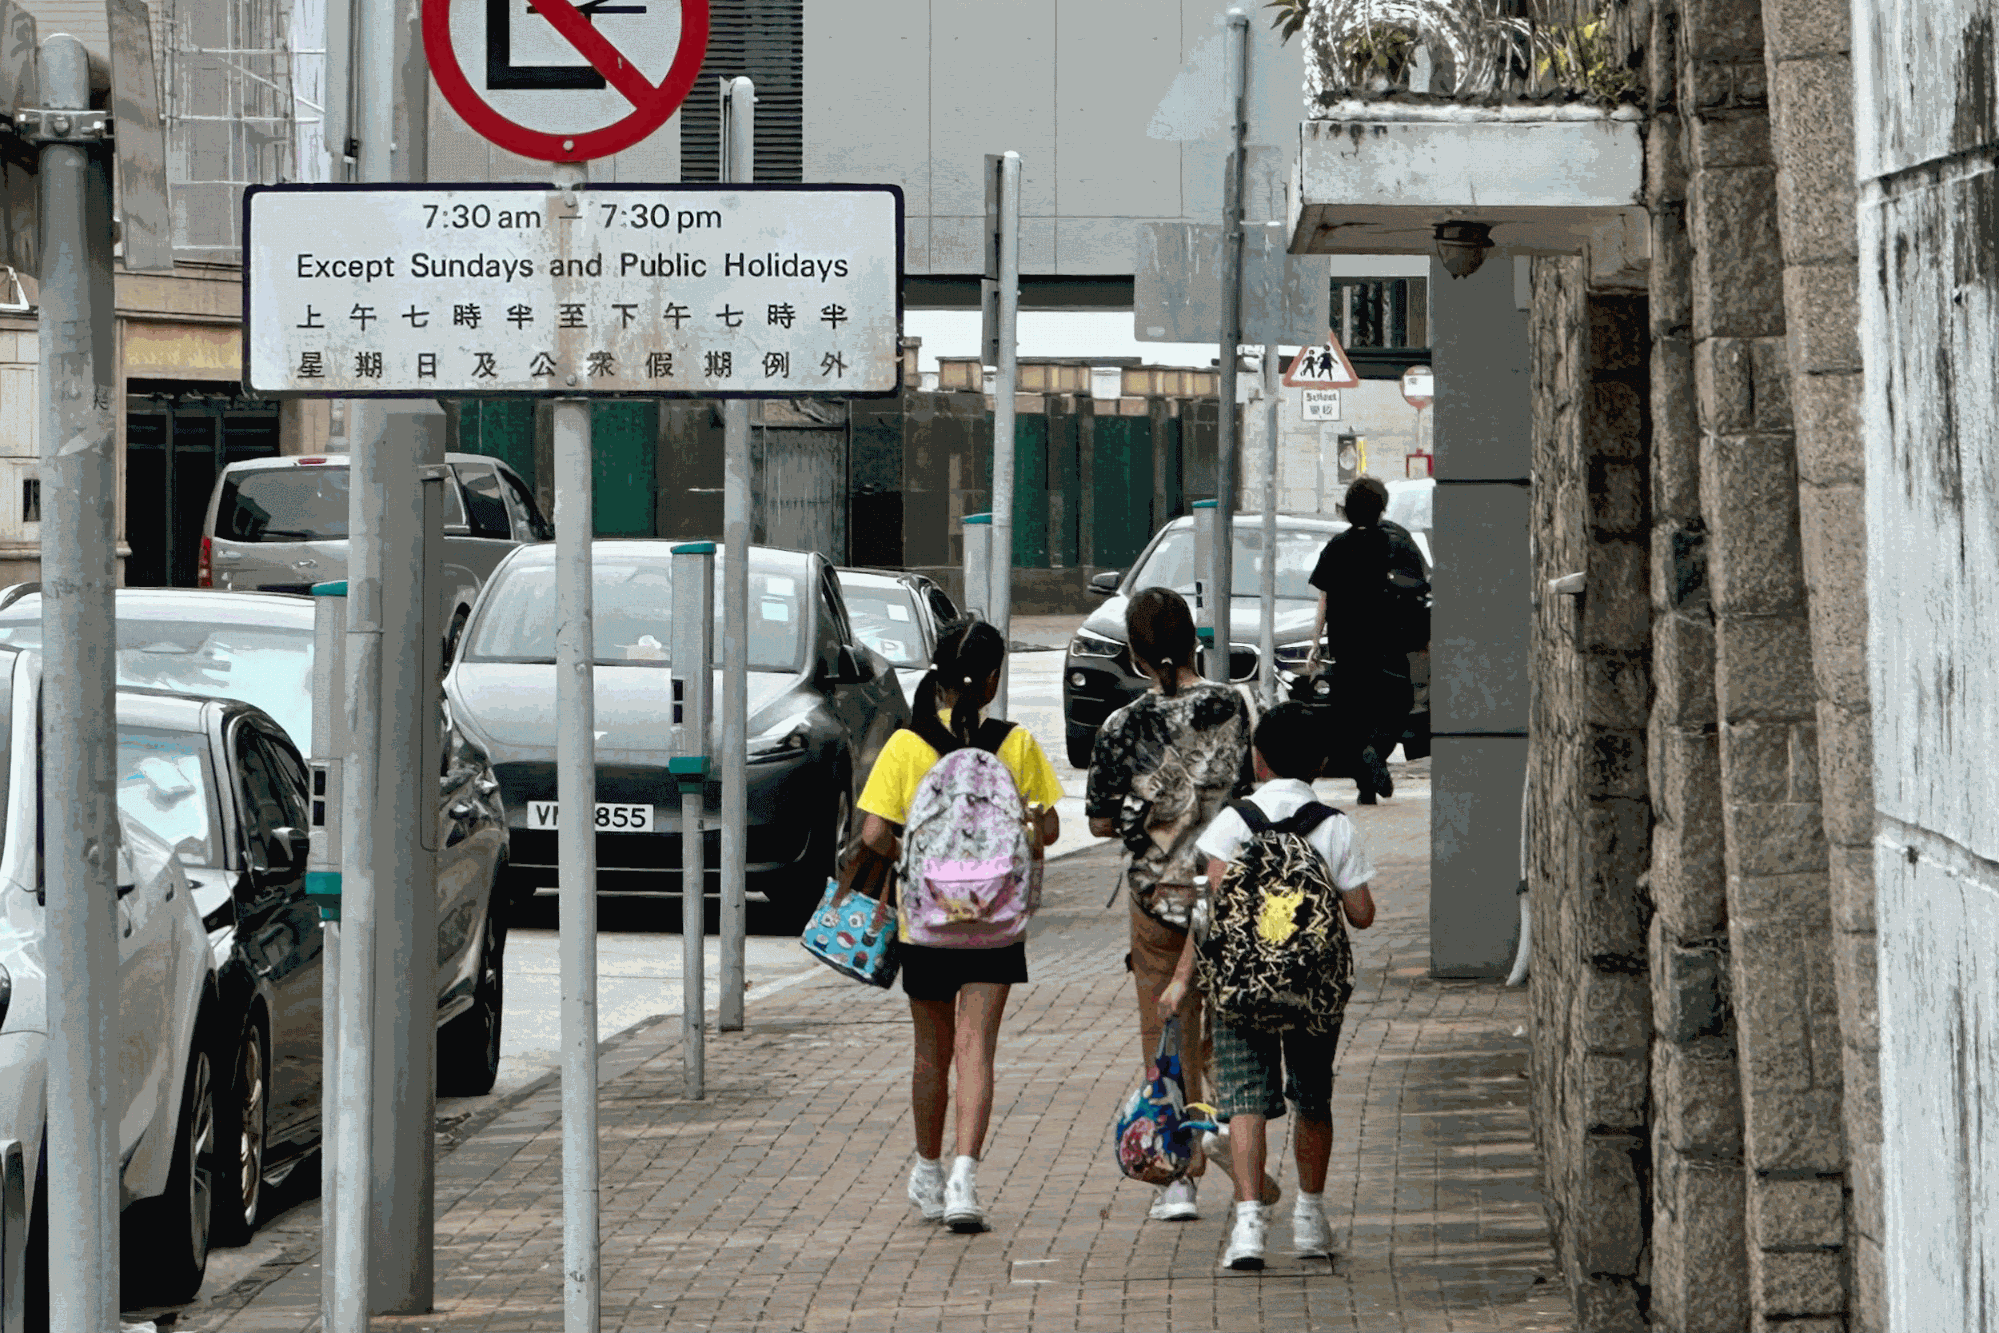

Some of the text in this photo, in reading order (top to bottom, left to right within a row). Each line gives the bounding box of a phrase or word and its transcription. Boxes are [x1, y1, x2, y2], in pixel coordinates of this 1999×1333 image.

[423, 203, 492, 229] 7:30
[498, 211, 542, 229] am
[601, 203, 670, 229] 7:30
[677, 210, 722, 234] pm
[297, 252, 848, 283] Except Sundays and Public Holidays
[296, 303, 848, 331] 上午七時半至下午七時半
[594, 806, 646, 828] 855
